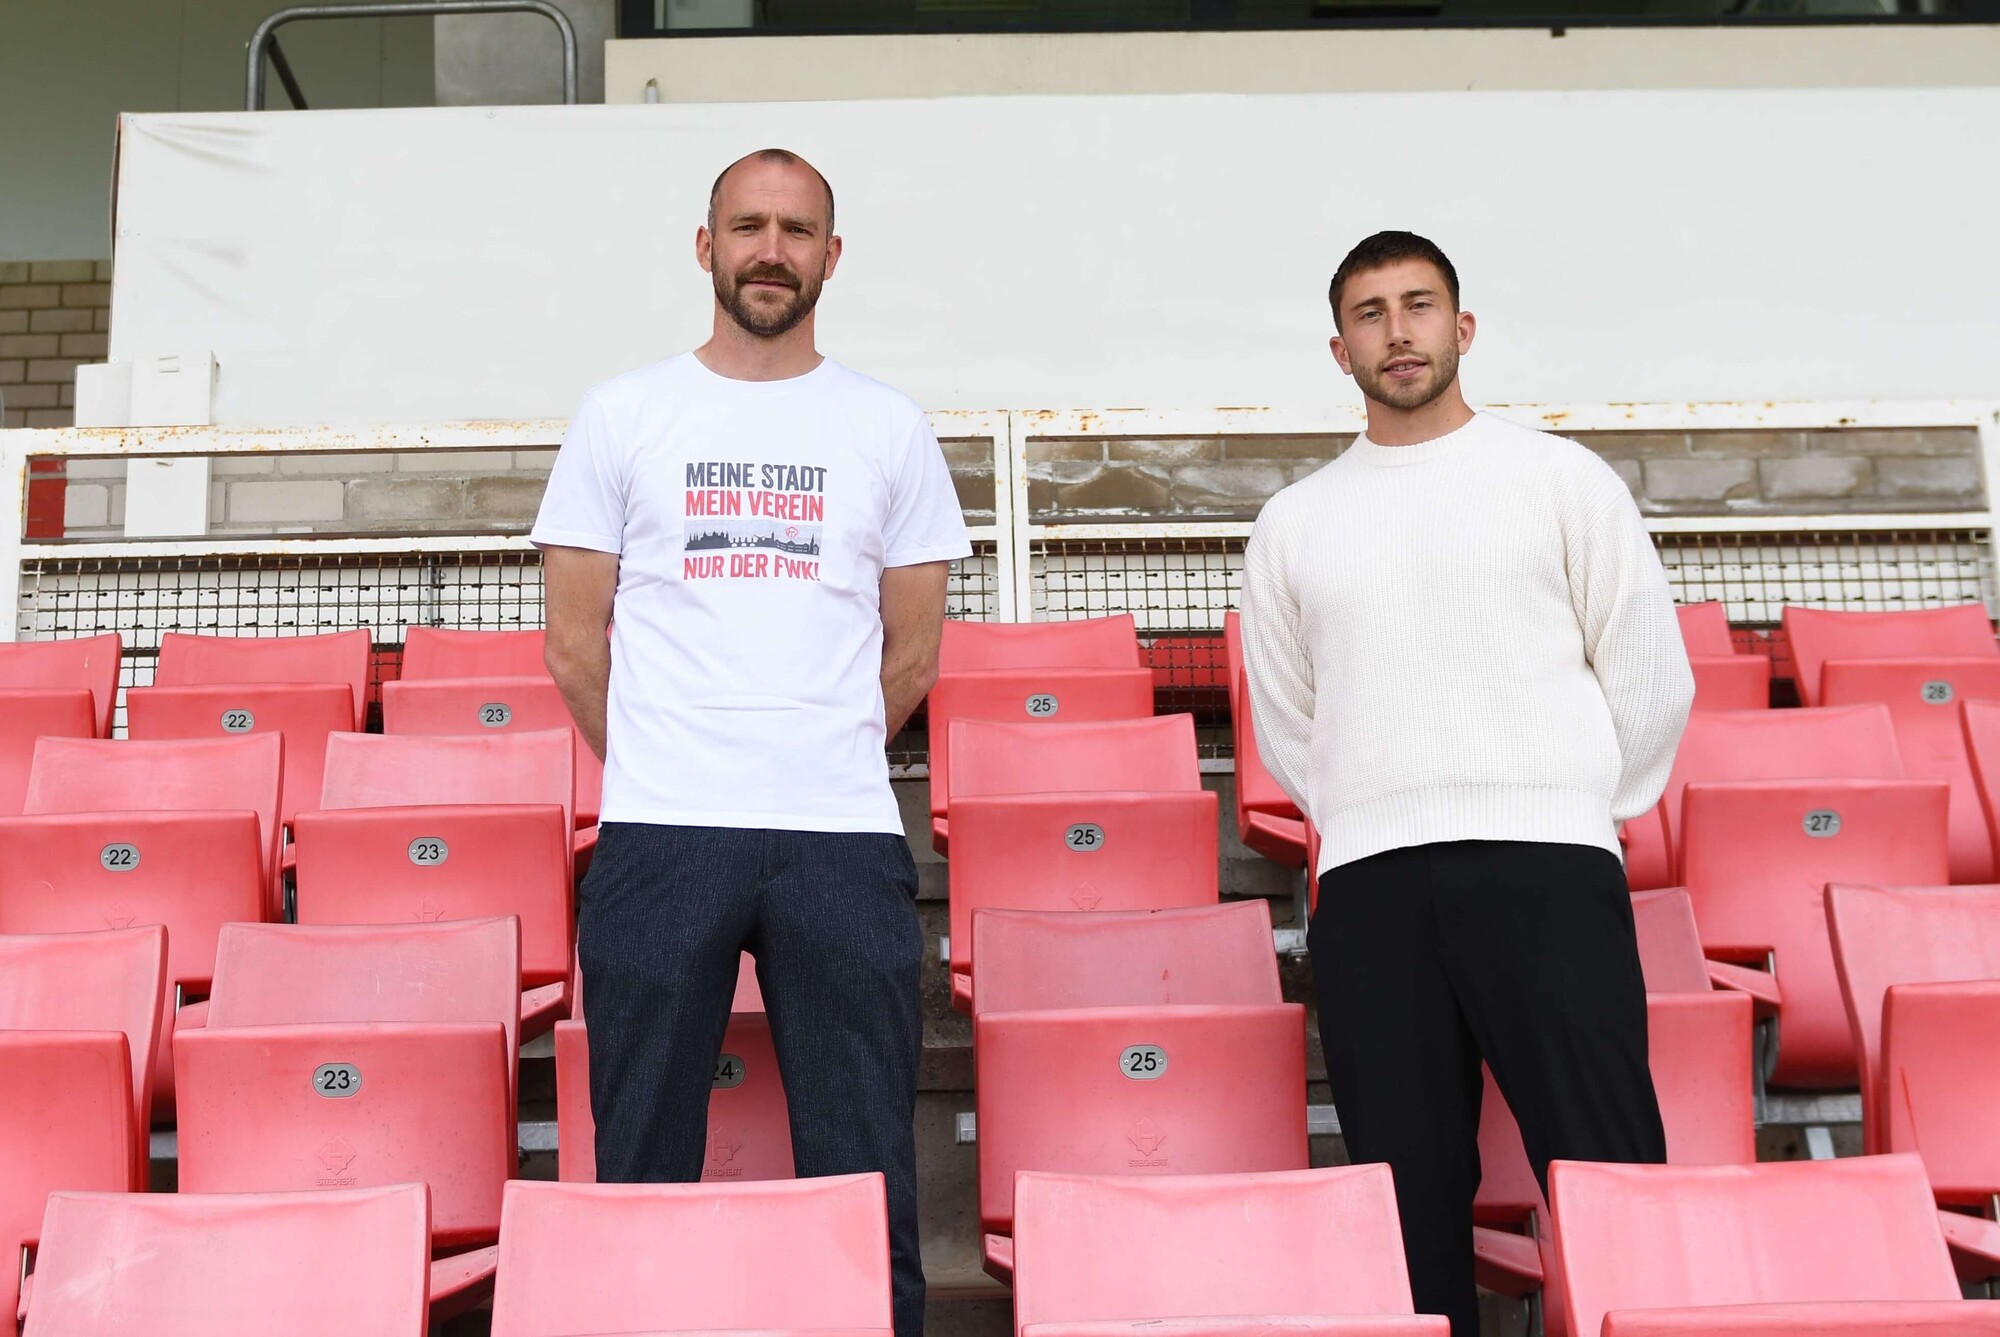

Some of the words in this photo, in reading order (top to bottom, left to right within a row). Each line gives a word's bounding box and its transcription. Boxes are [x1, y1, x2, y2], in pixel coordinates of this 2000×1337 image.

[686, 463, 755, 488] MEINE
[761, 464, 827, 492] STADT
[685, 490, 741, 517] MEIN
[747, 491, 824, 522] VEREIN
[683, 555, 725, 580] NUR
[730, 554, 768, 578] DER
[774, 555, 821, 582] FWK!
[1033, 699, 1051, 712] 25
[228, 714, 247, 728] 22
[486, 709, 504, 722] 23
[1811, 815, 1832, 831] 27
[1073, 829, 1095, 845] 25
[109, 849, 131, 865] 22
[417, 844, 439, 860] 23
[1130, 1052, 1157, 1071] 25
[323, 1070, 350, 1089] 23
